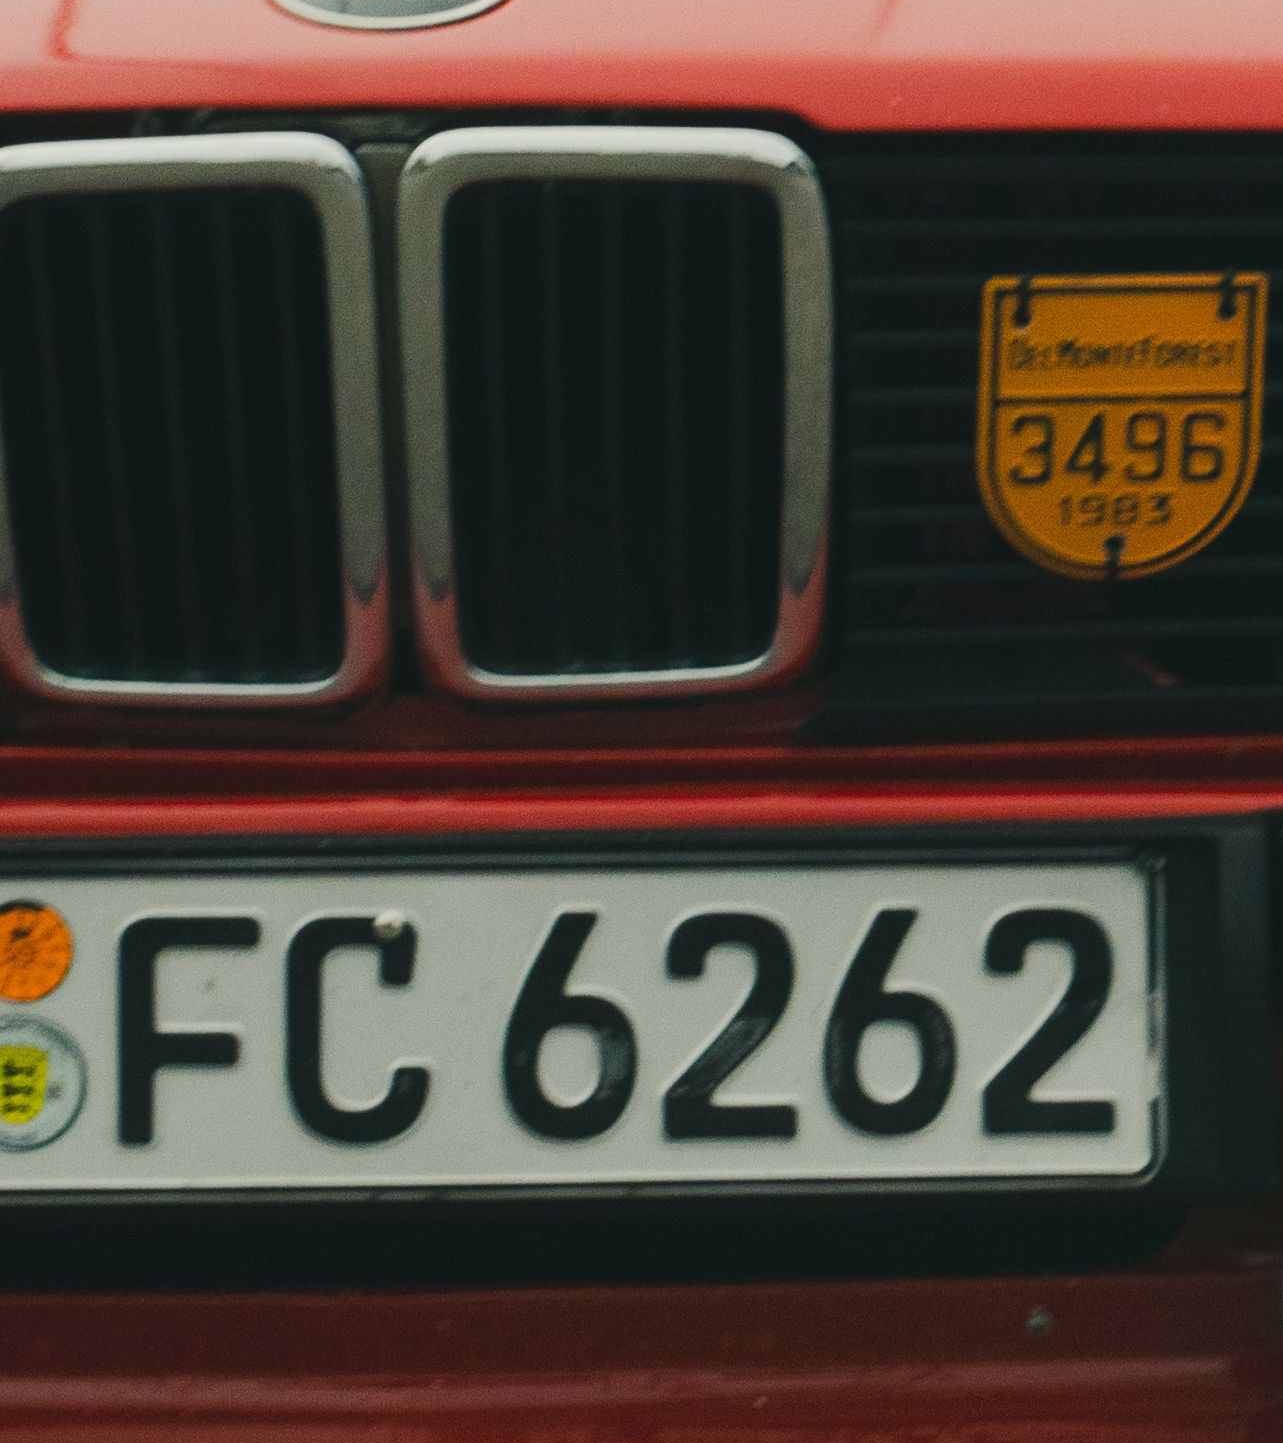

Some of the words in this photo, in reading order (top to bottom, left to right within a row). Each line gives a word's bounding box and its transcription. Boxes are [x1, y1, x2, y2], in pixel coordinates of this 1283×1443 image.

[1009, 412, 1228, 485] 3496
[1059, 492, 1174, 528] 1983
[118, 915, 431, 1147] FC
[501, 910, 1116, 1143] 6262
